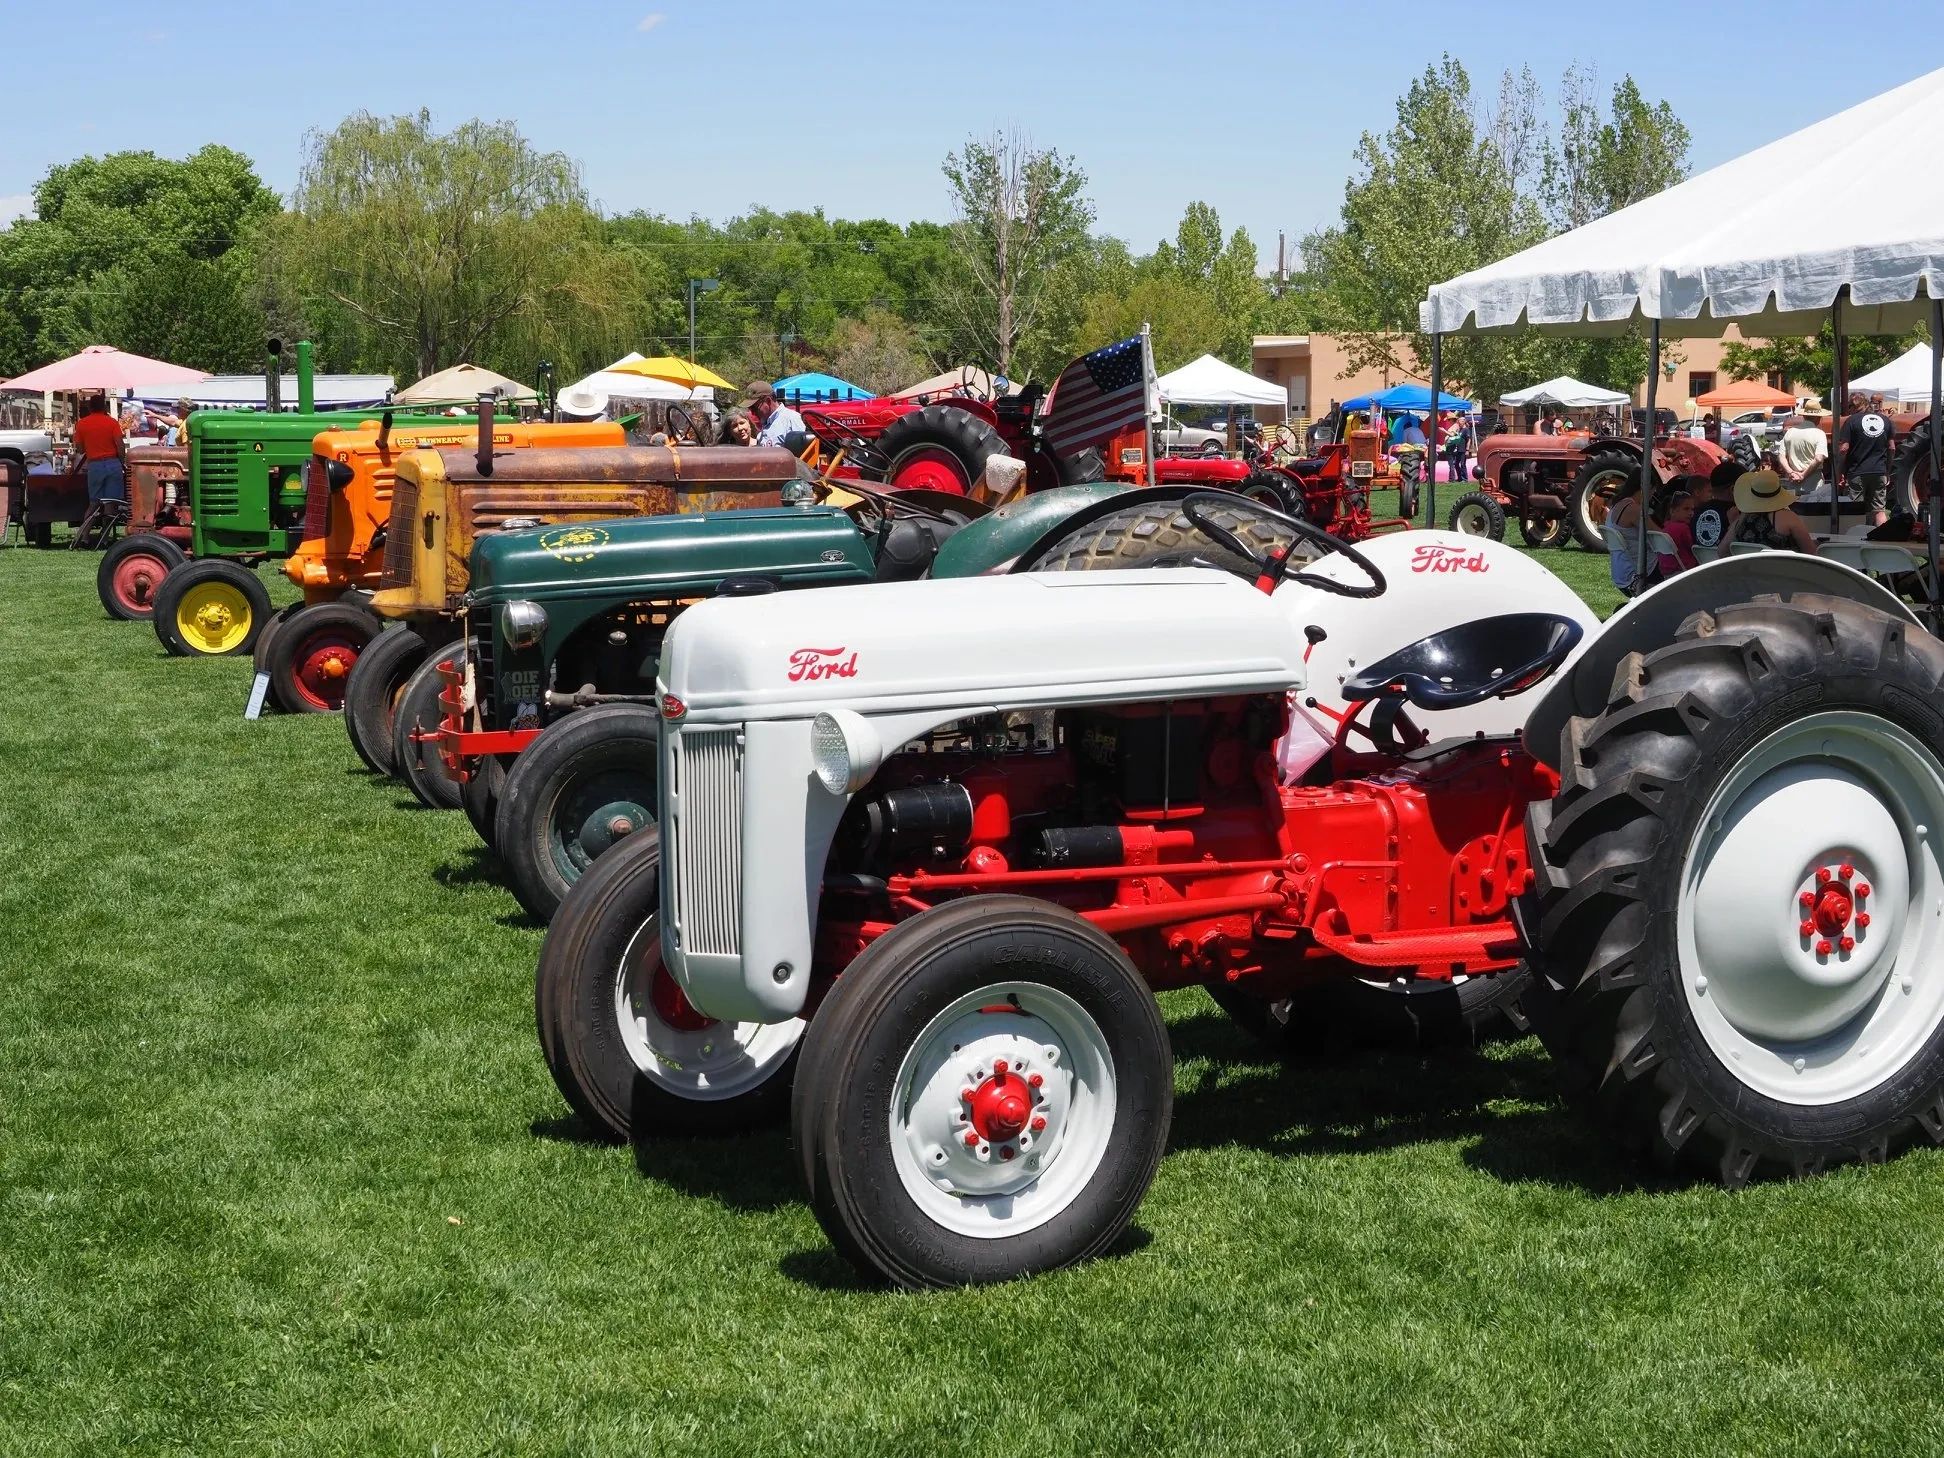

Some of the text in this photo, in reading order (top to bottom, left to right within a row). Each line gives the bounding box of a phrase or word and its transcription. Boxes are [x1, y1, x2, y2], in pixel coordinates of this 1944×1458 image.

[1411, 545, 1490, 573] Ford
[788, 647, 858, 681] Ford
[992, 944, 1129, 1014] CARLISLE
